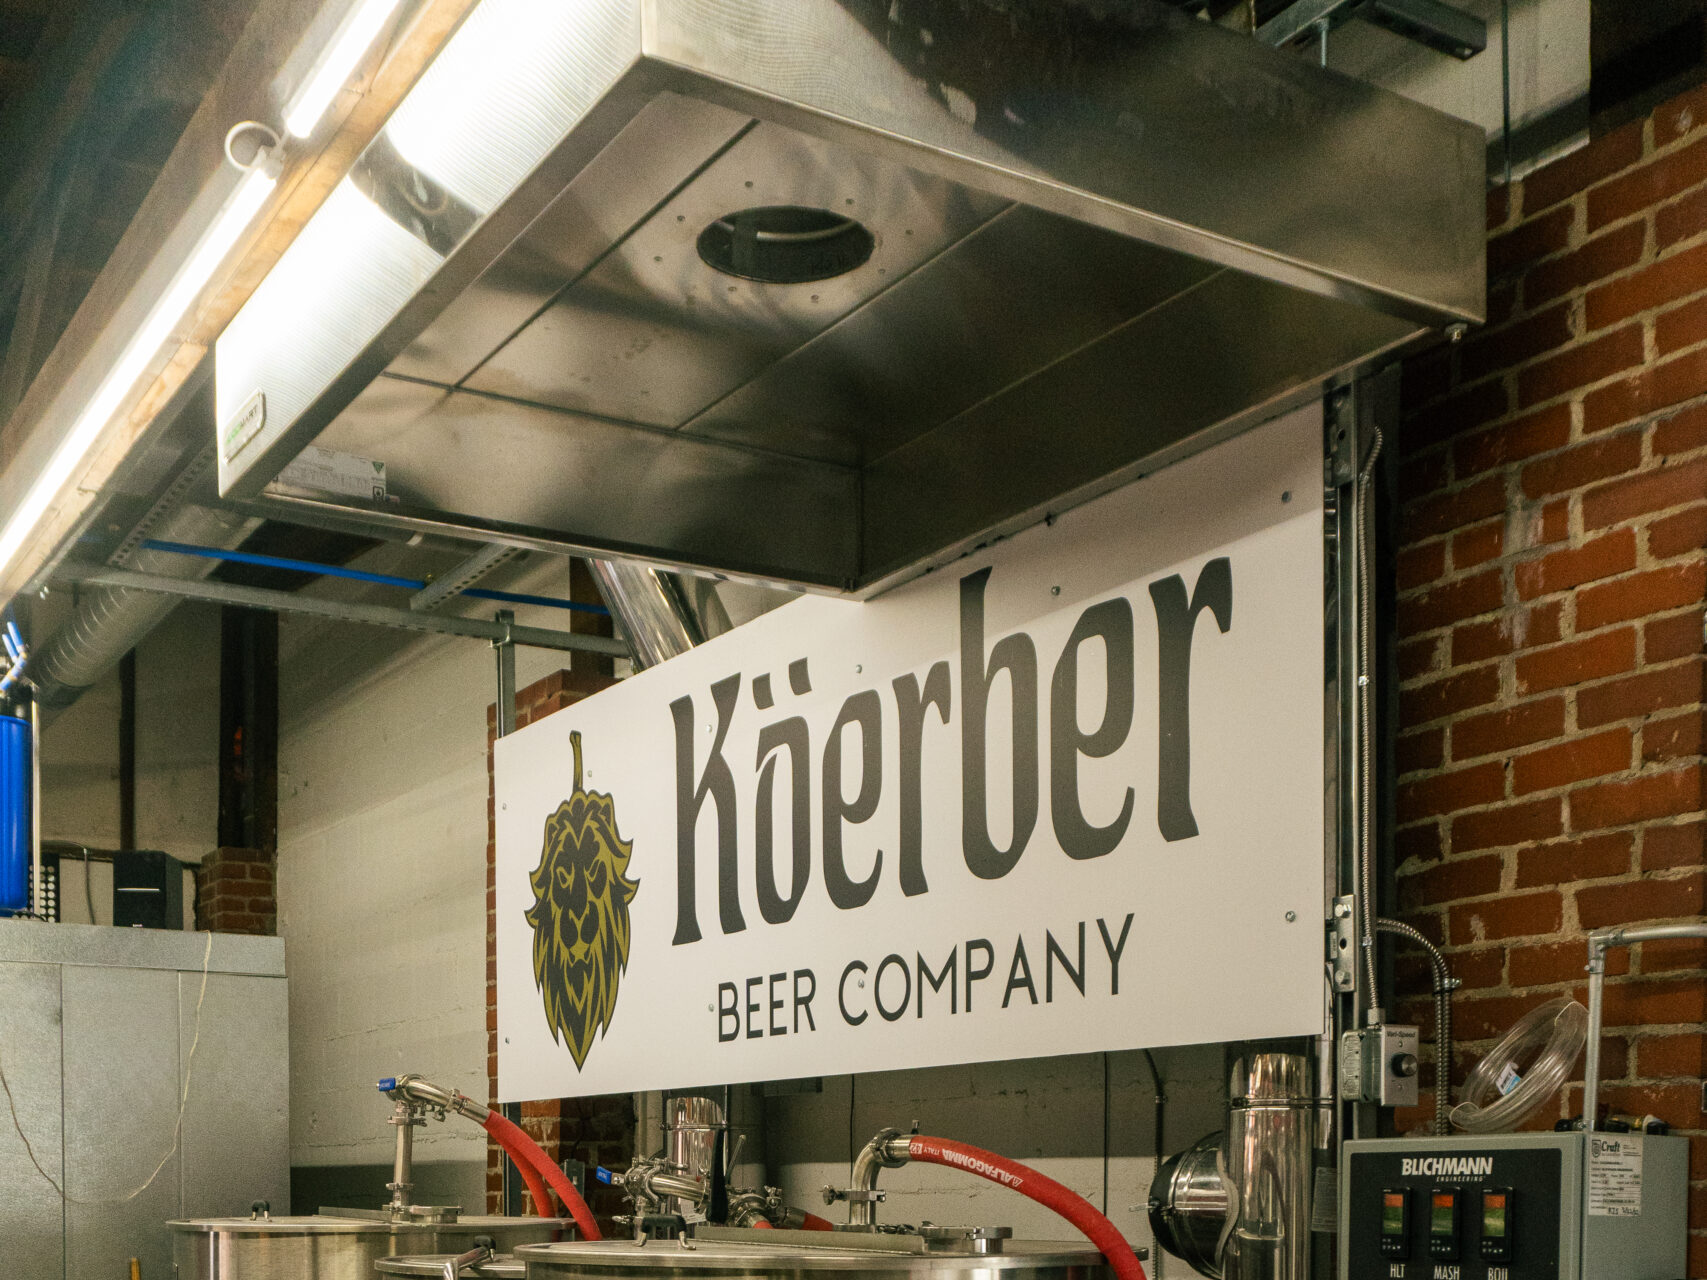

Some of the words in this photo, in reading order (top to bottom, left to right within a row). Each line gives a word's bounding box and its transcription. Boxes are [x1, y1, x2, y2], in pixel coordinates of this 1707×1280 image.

[669, 556, 1233, 946] Köerber
[718, 968, 817, 1043] BEER
[838, 912, 1135, 1027] COMPANY
[924, 1146, 940, 1156] ITALY
[942, 1148, 1014, 1184] ALFAGOMMA
[1402, 1157, 1493, 1176] BLICHMANN
[1436, 1175, 1484, 1183] ENGINEERING
[1390, 1264, 1406, 1278] HLT
[1434, 1265, 1460, 1280] MASH
